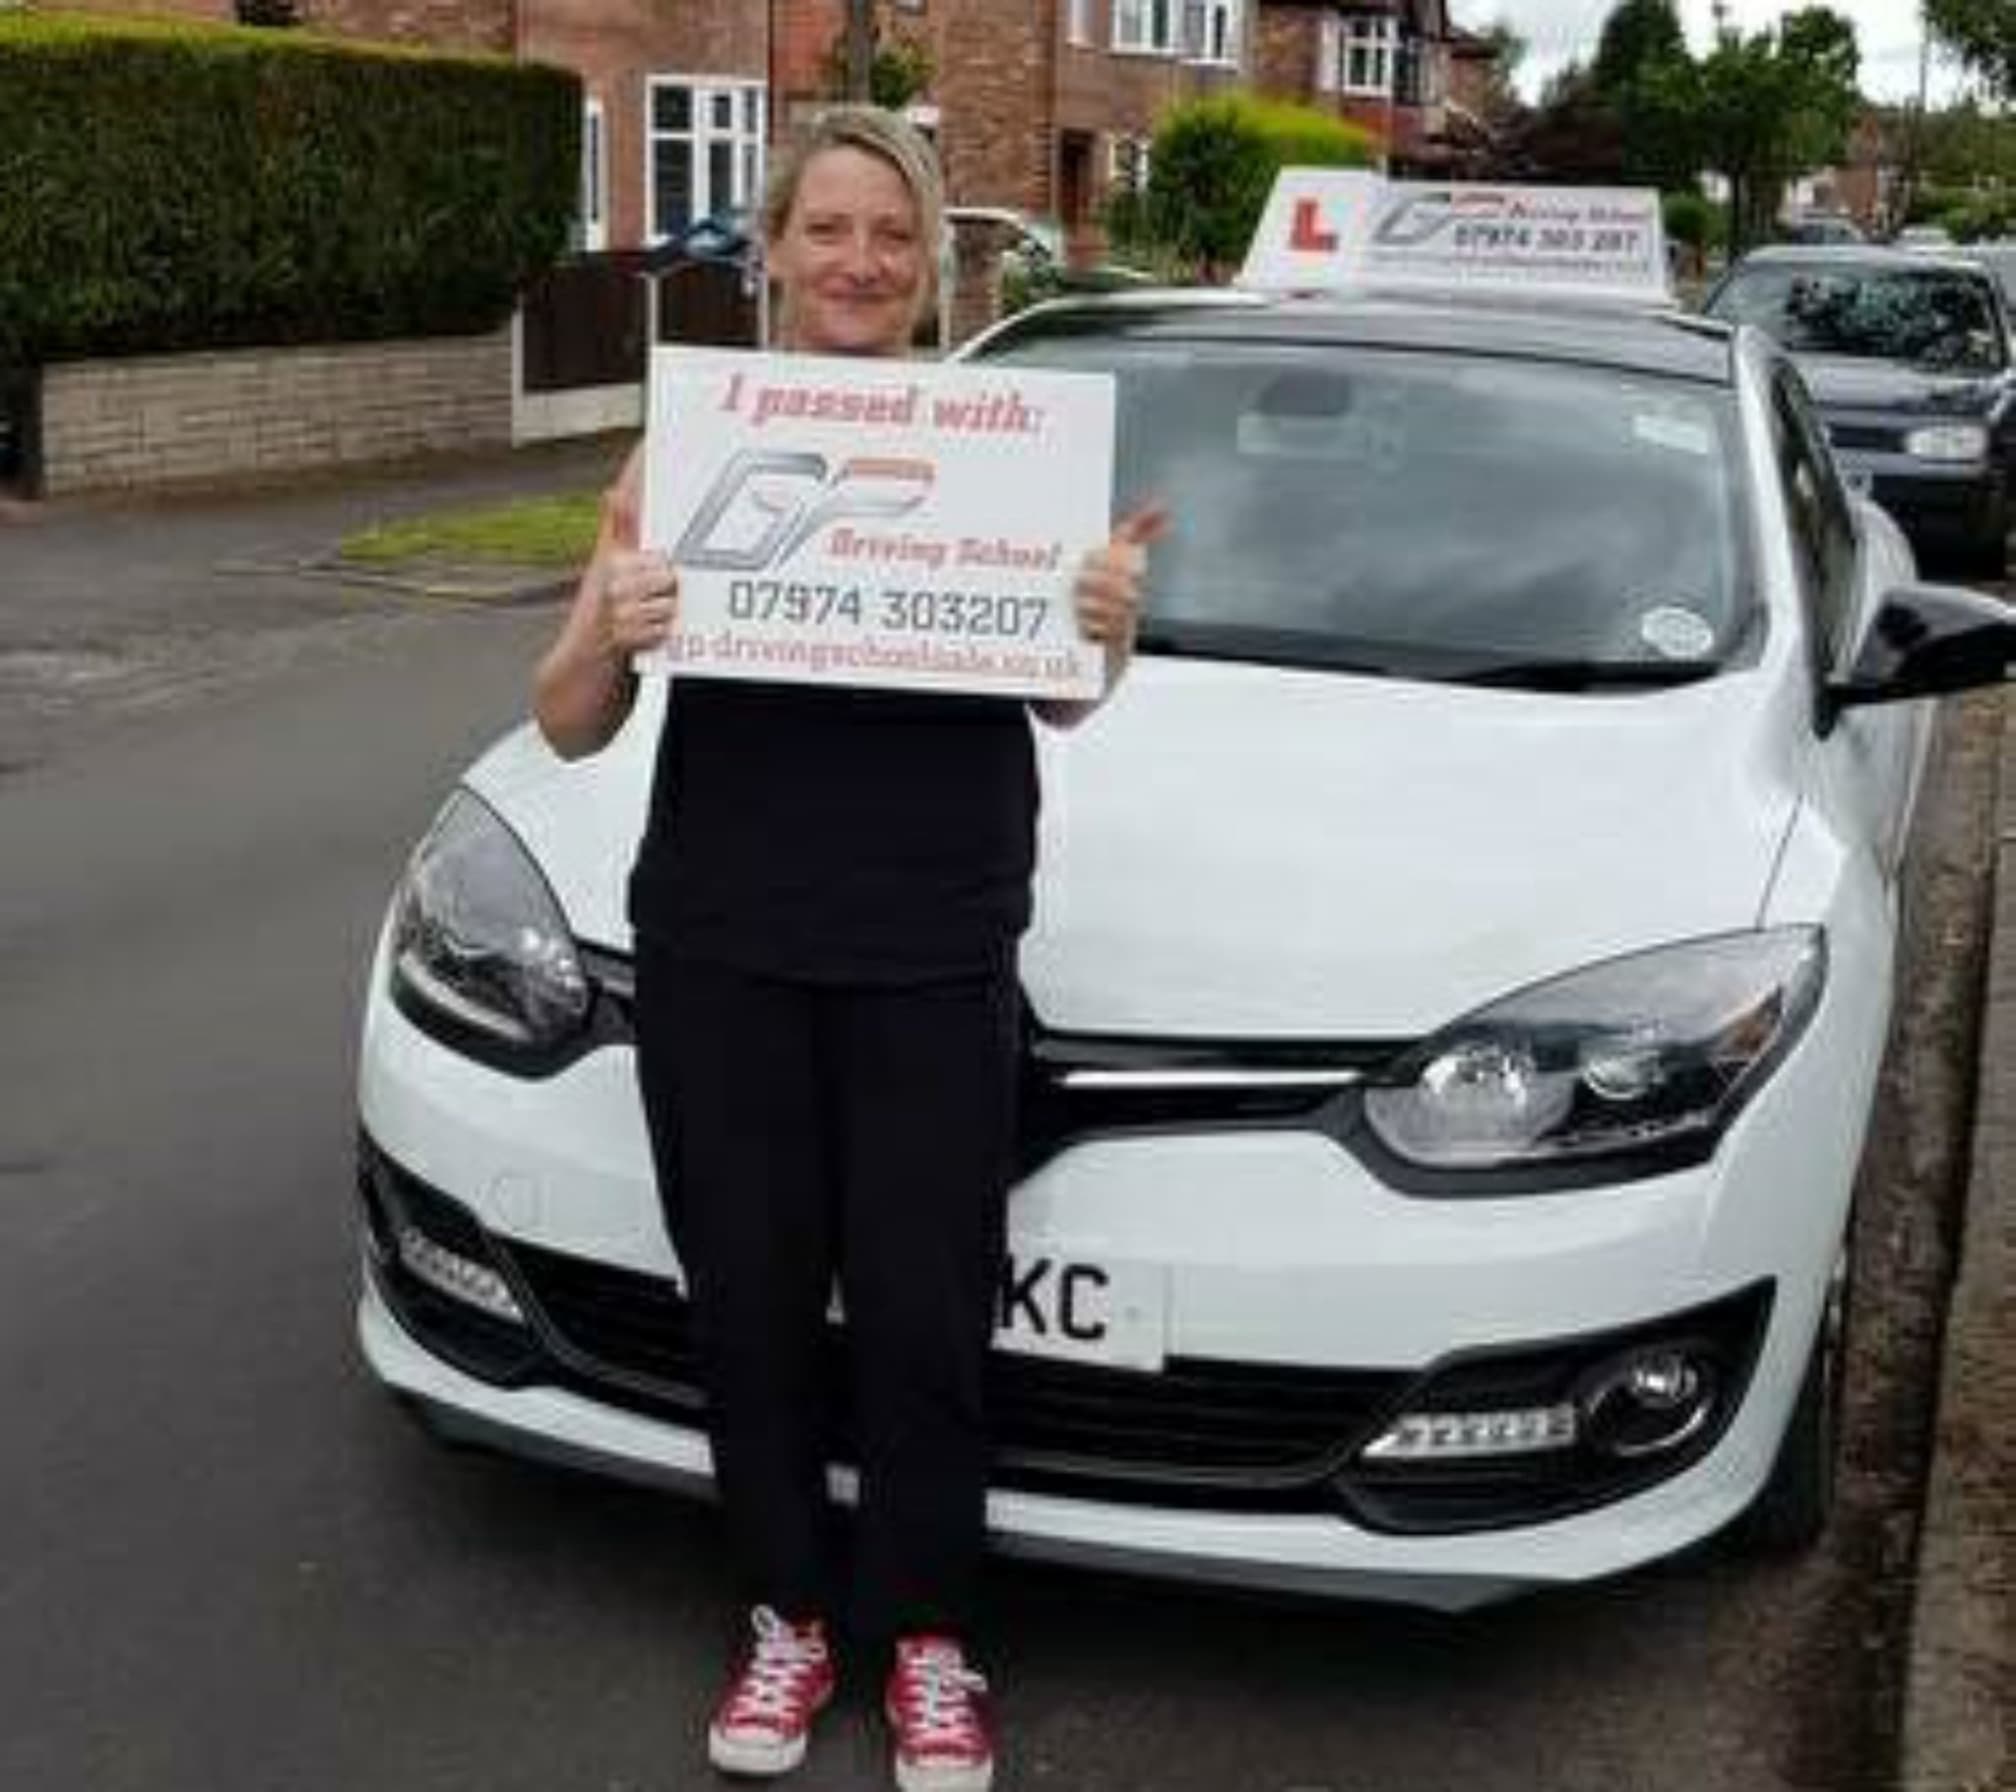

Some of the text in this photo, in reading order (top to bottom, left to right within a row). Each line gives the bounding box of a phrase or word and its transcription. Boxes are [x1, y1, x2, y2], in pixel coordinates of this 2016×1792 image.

[1289, 197, 1338, 252] L
[718, 372, 742, 412] I
[749, 384, 918, 427] passed
[830, 526, 1062, 571] Driving School
[729, 581, 1049, 640] 07974 303207
